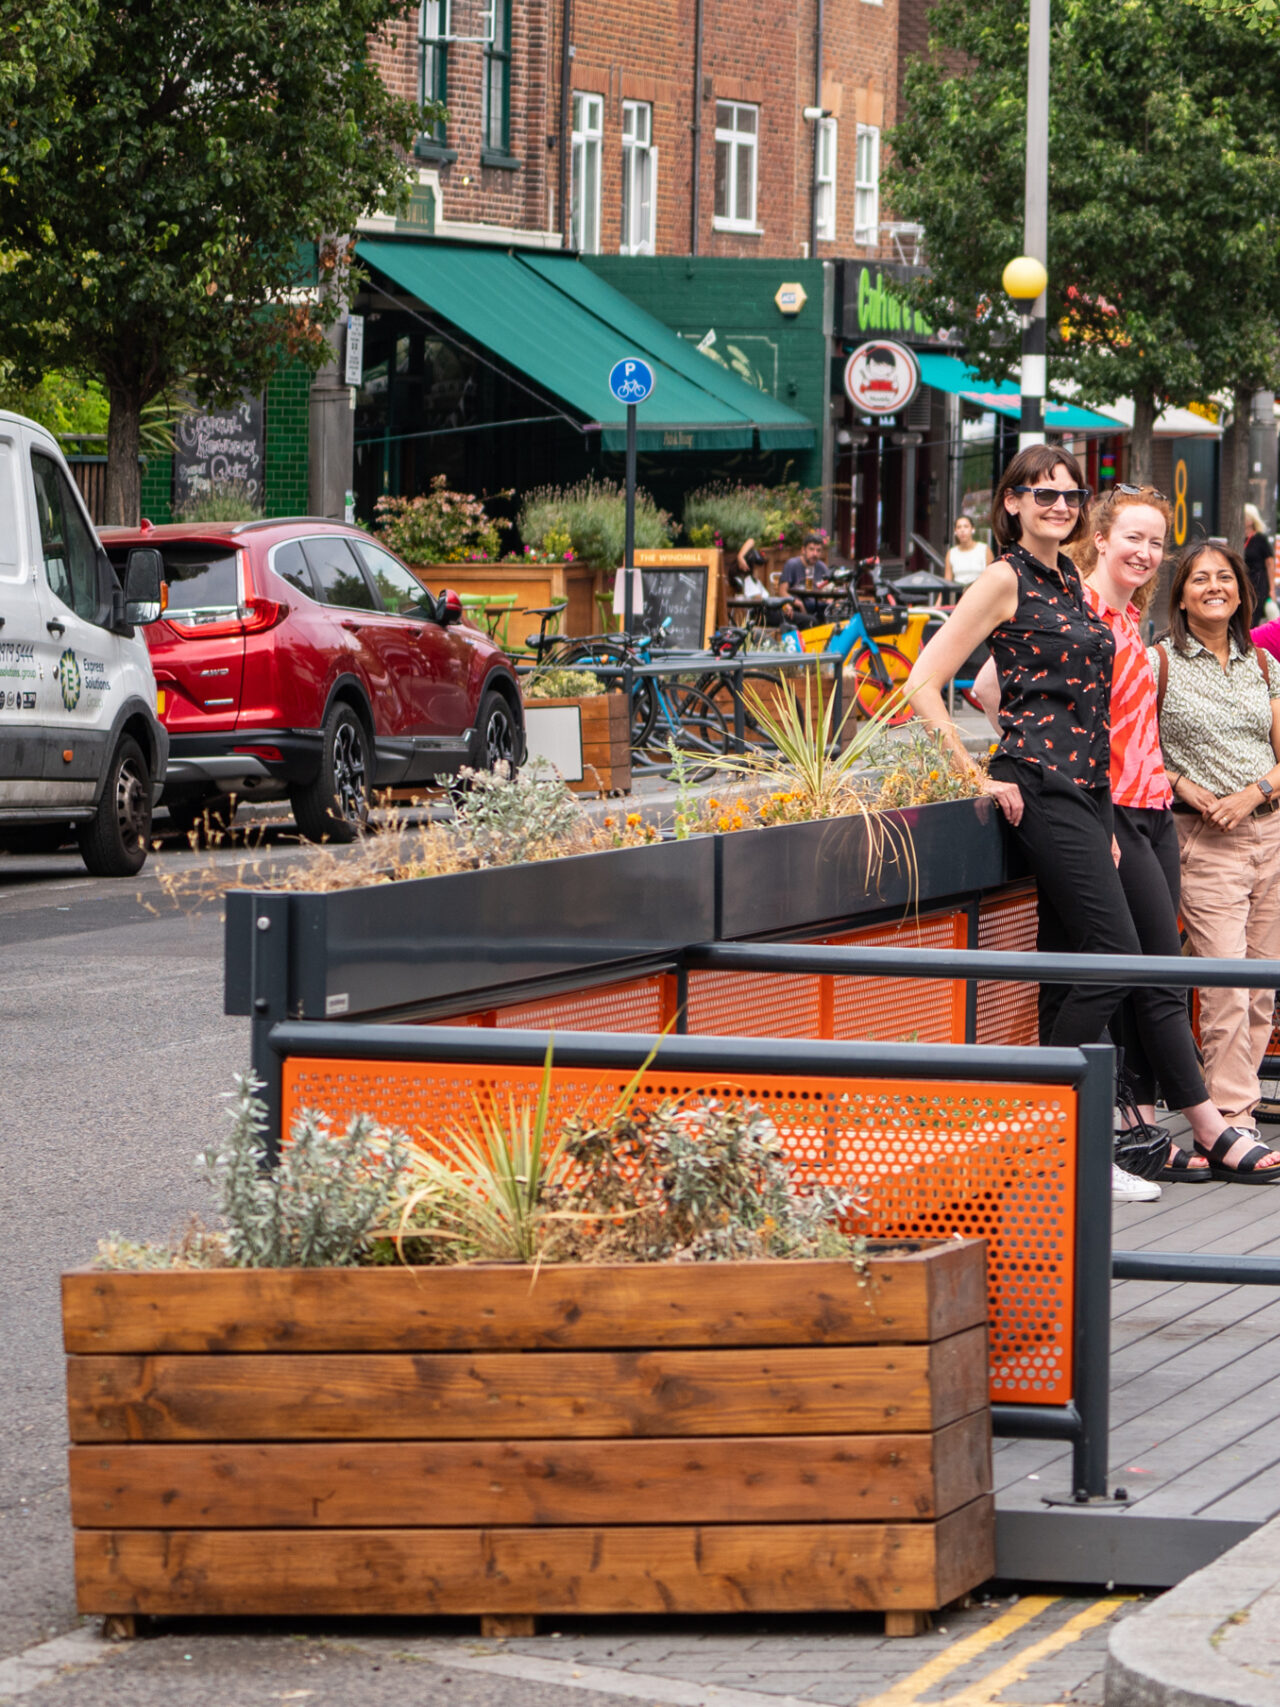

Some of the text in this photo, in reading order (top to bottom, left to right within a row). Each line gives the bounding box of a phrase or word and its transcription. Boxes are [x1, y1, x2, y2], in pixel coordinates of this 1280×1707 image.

[625, 362, 636, 377] P
[640, 553, 702, 561] THE WINDMILL
[83, 658, 105, 675] Express
